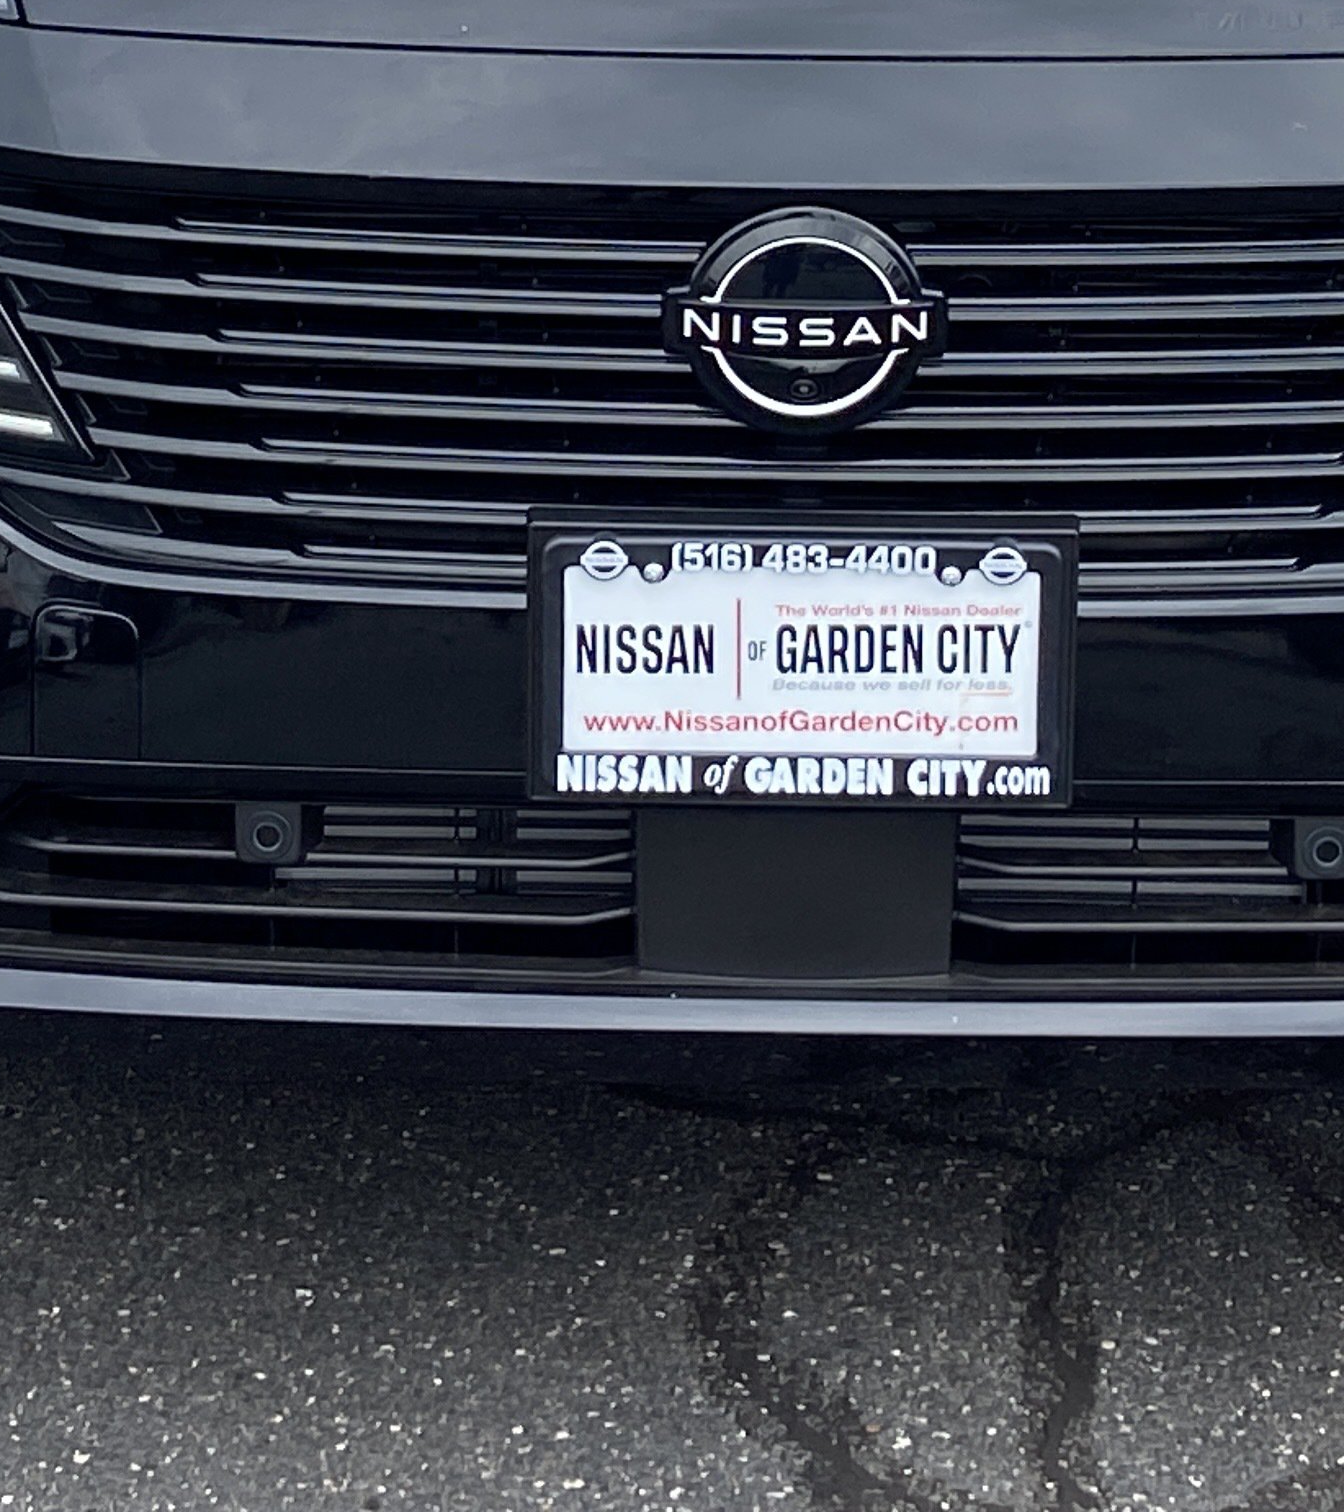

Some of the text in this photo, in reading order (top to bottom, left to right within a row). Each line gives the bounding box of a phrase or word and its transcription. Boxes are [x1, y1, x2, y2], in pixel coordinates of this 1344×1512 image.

[683, 308, 928, 347] NISSAN
[670, 542, 937, 576] (516) 483-4400
[775, 604, 1022, 618] The World's #1 Nissan Dealer
[576, 623, 1022, 675] NISSAN OF GARDEN CITY
[772, 678, 856, 692] Because
[862, 681, 899, 692] we
[904, 678, 932, 692] sell
[937, 678, 962, 692] for
[583, 709, 1020, 738] www.NissanofGardenCity.com
[557, 754, 1051, 798] NISSAN of GARDEN CITY.com
